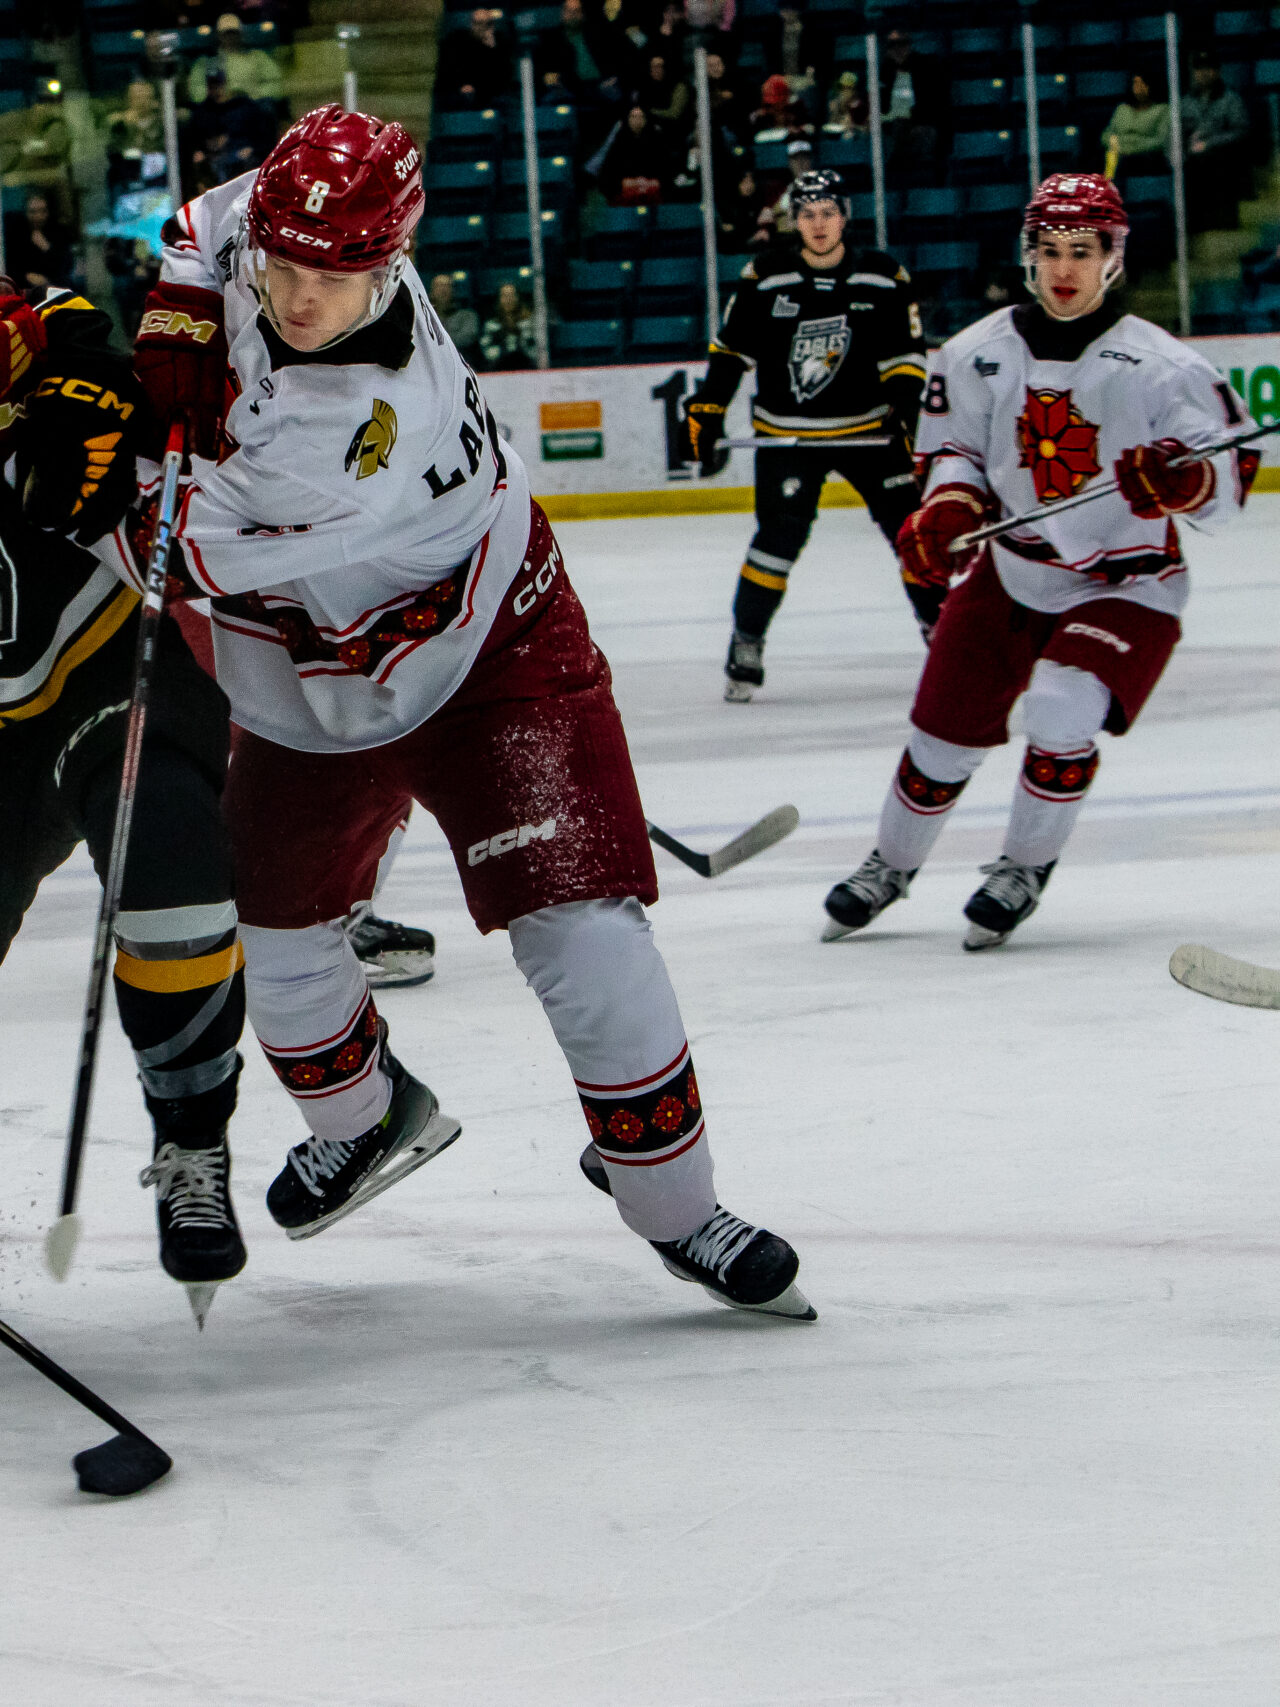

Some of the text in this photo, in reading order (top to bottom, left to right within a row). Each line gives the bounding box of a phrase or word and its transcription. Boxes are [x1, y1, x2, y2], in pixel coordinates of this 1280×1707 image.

[304, 180, 331, 214] 8
[279, 226, 333, 250] CCM
[138, 310, 218, 344] CM
[1099, 350, 1142, 366] CCM
[35, 376, 135, 421] CCM
[513, 538, 560, 616] CCM
[467, 819, 557, 867] CCM
